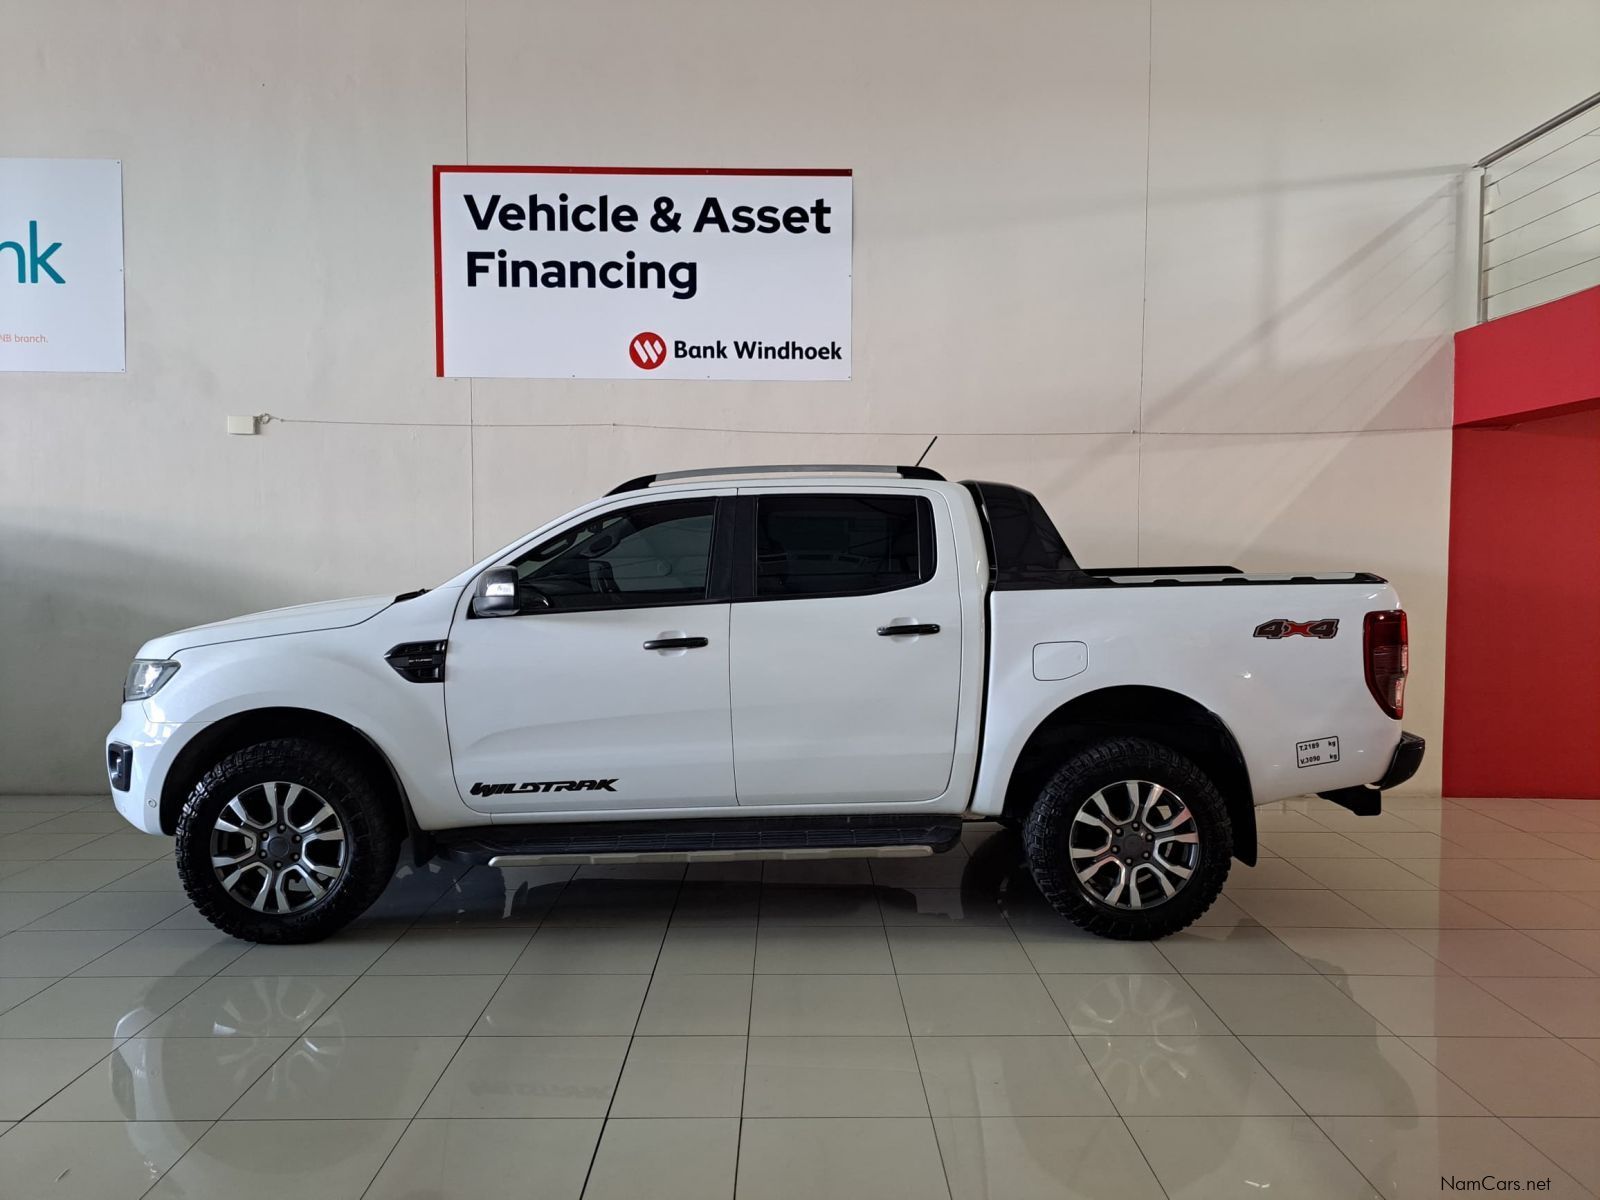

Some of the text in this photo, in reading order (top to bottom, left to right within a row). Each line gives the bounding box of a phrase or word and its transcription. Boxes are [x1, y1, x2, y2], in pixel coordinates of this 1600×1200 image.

[463, 193, 832, 235] Vehicle & Asset
[467, 249, 698, 300] Financing
[14, 333, 49, 344] branch.
[674, 340, 842, 361] Bank Windhoek
[1328, 740, 1336, 748] kg
[470, 778, 619, 797] WILDTRAK
